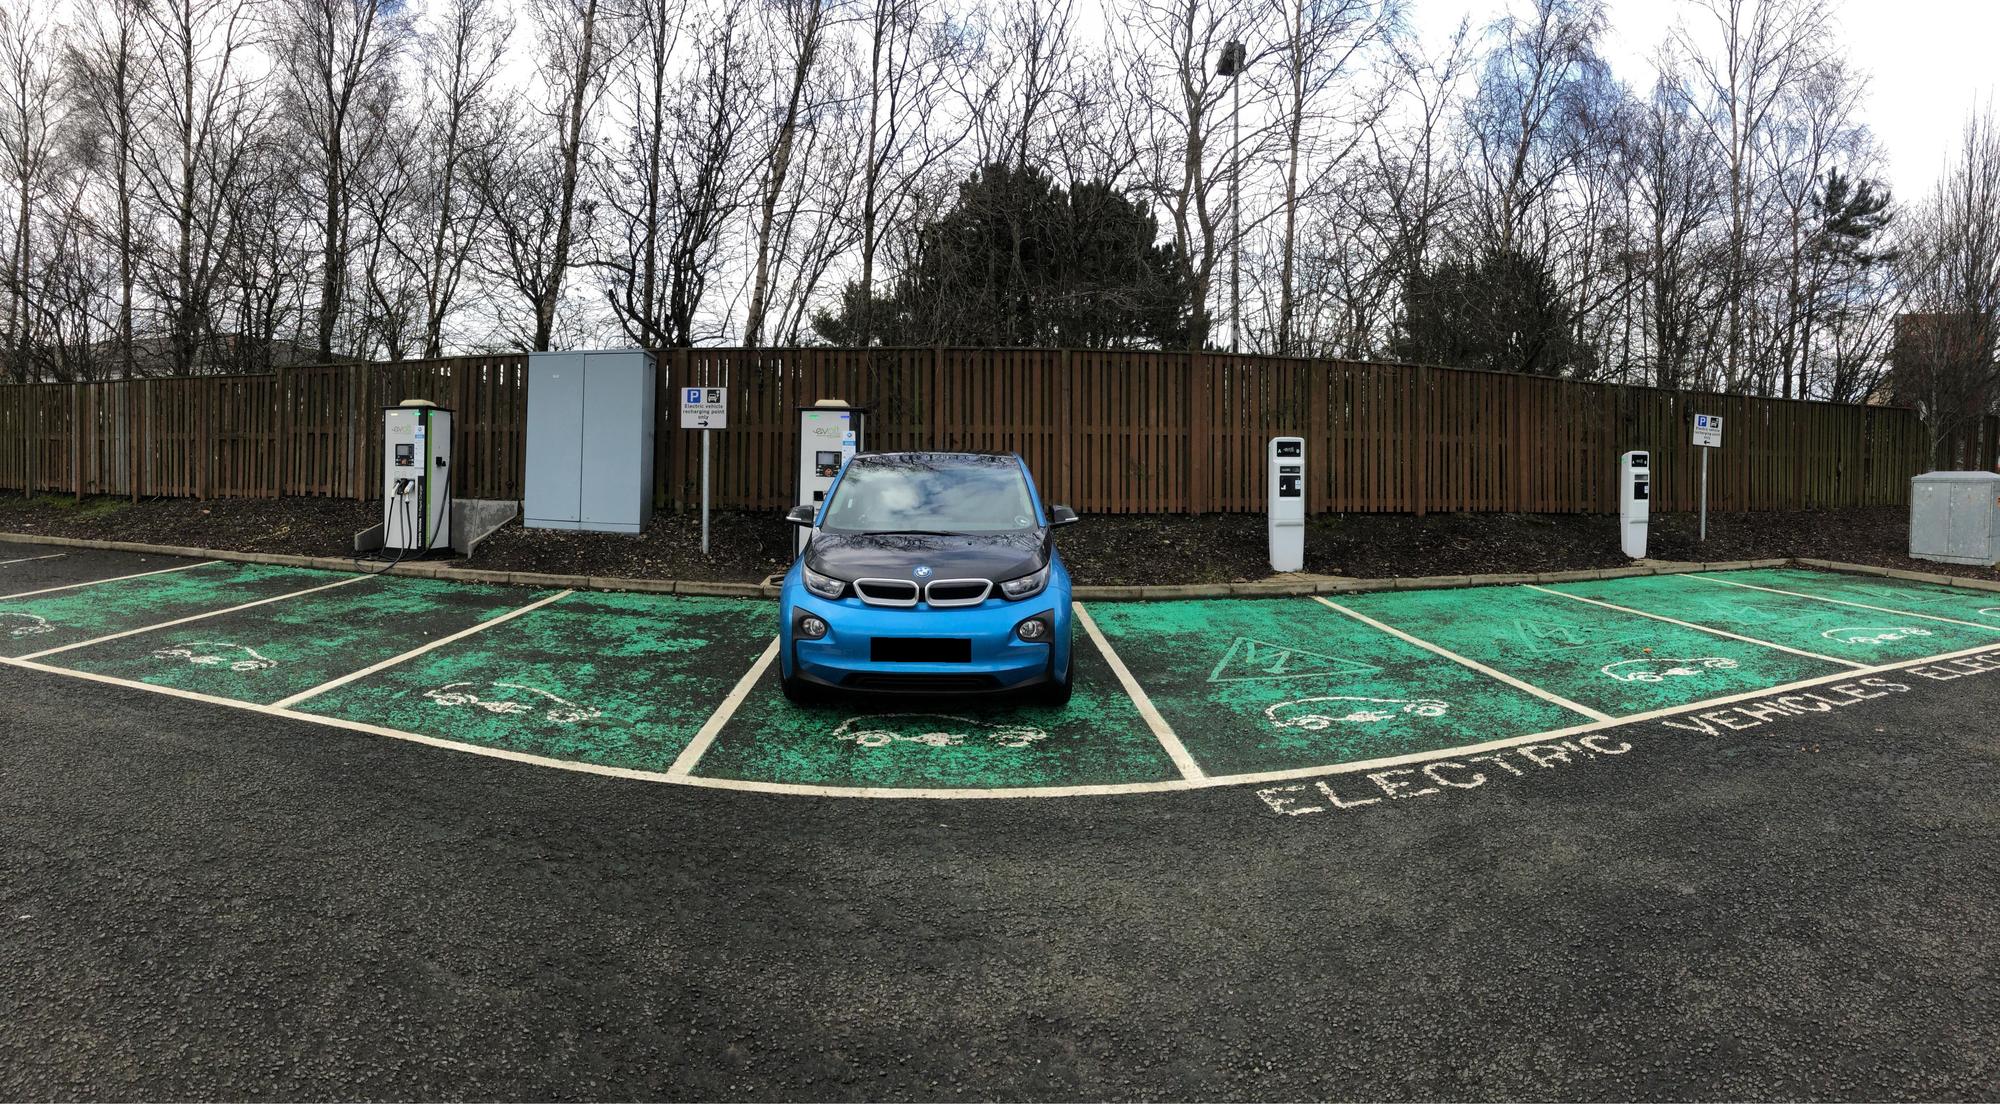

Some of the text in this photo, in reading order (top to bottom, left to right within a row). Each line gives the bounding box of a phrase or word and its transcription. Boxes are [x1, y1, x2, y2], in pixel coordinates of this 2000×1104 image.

[690, 390, 699, 402] P
[1256, 677, 1912, 816] ELECTRIC VEHICLES
